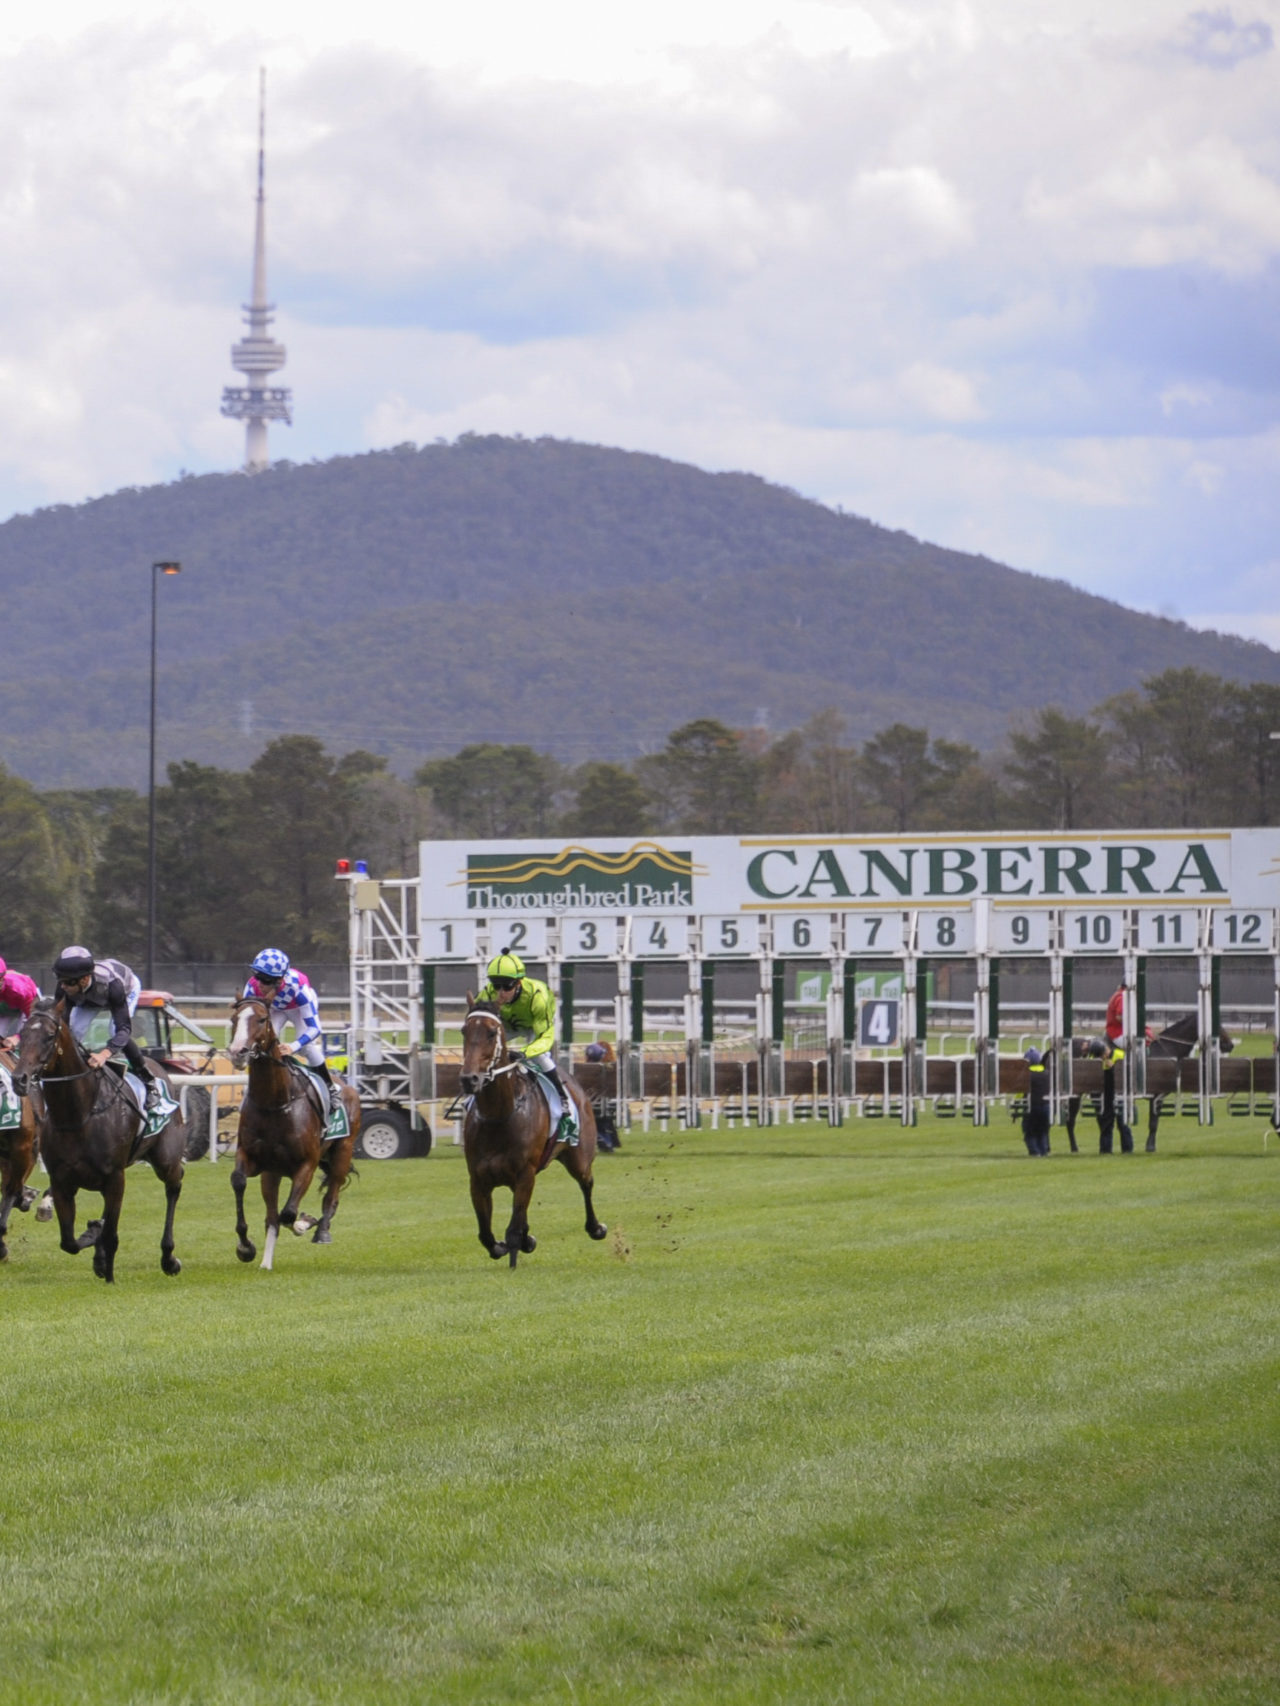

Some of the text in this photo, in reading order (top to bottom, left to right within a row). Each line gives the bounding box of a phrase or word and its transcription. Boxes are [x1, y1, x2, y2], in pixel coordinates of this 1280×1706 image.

[746, 844, 1228, 899] CANBERRA
[470, 882, 690, 913] Thoroughbred Park
[440, 913, 1262, 953] 1 2 3 4 5 6 7 8 9 10 11 12
[867, 1003, 890, 1043] 4
